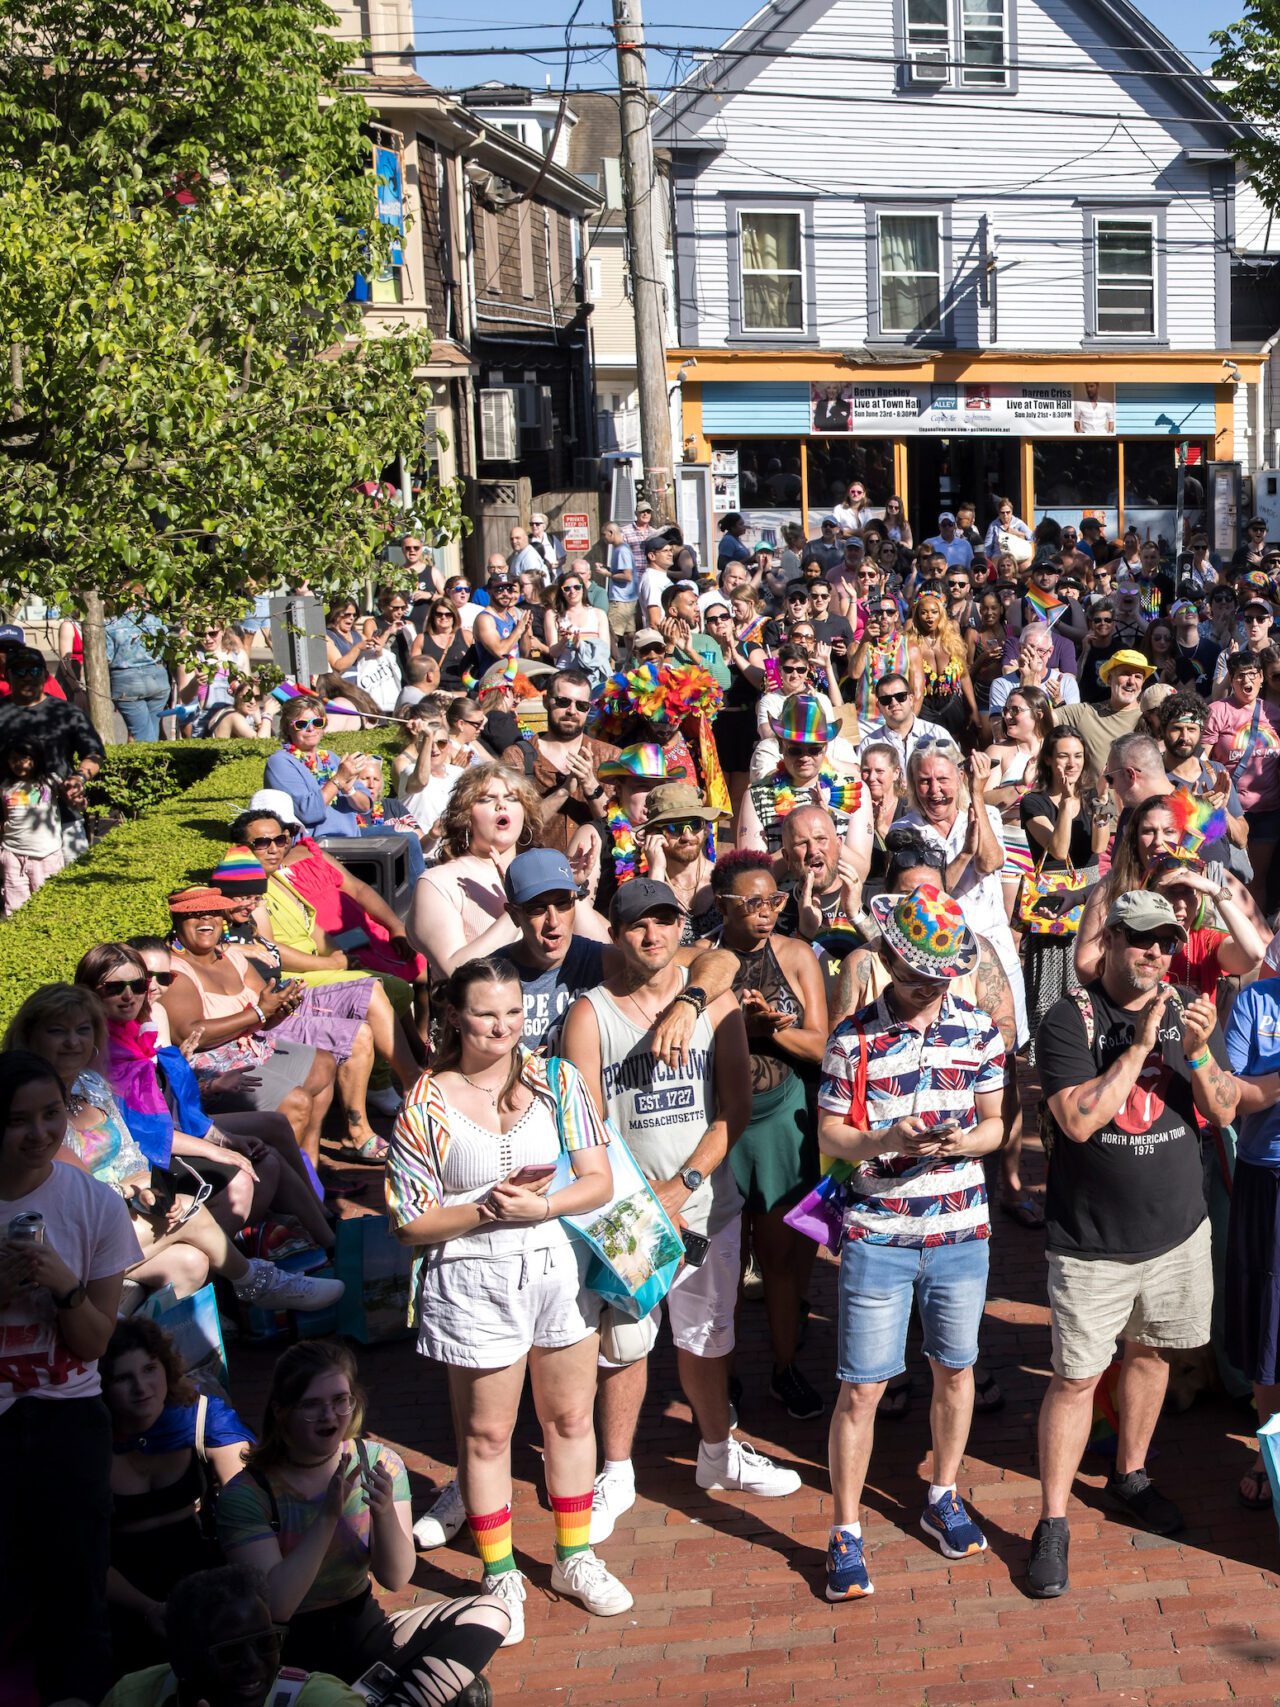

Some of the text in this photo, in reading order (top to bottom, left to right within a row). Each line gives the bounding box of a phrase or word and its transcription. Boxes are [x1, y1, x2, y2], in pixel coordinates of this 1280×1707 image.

[854, 387, 911, 398] Betty Buckley
[1022, 388, 1072, 398] Darren Criss
[854, 399, 921, 409] Live at Town Hall
[934, 400, 955, 408] ALLEY
[1006, 400, 1072, 410] Live at Town Hall
[522, 993, 550, 1018] PE
[522, 1017, 550, 1037] 602
[638, 1089, 692, 1111] EST. 1727
[629, 1110, 705, 1130] MASSACHUSETTS
[1101, 1126, 1186, 1146] NORTH AMERICAN TOUR
[1133, 1145, 1155, 1156] 1975
